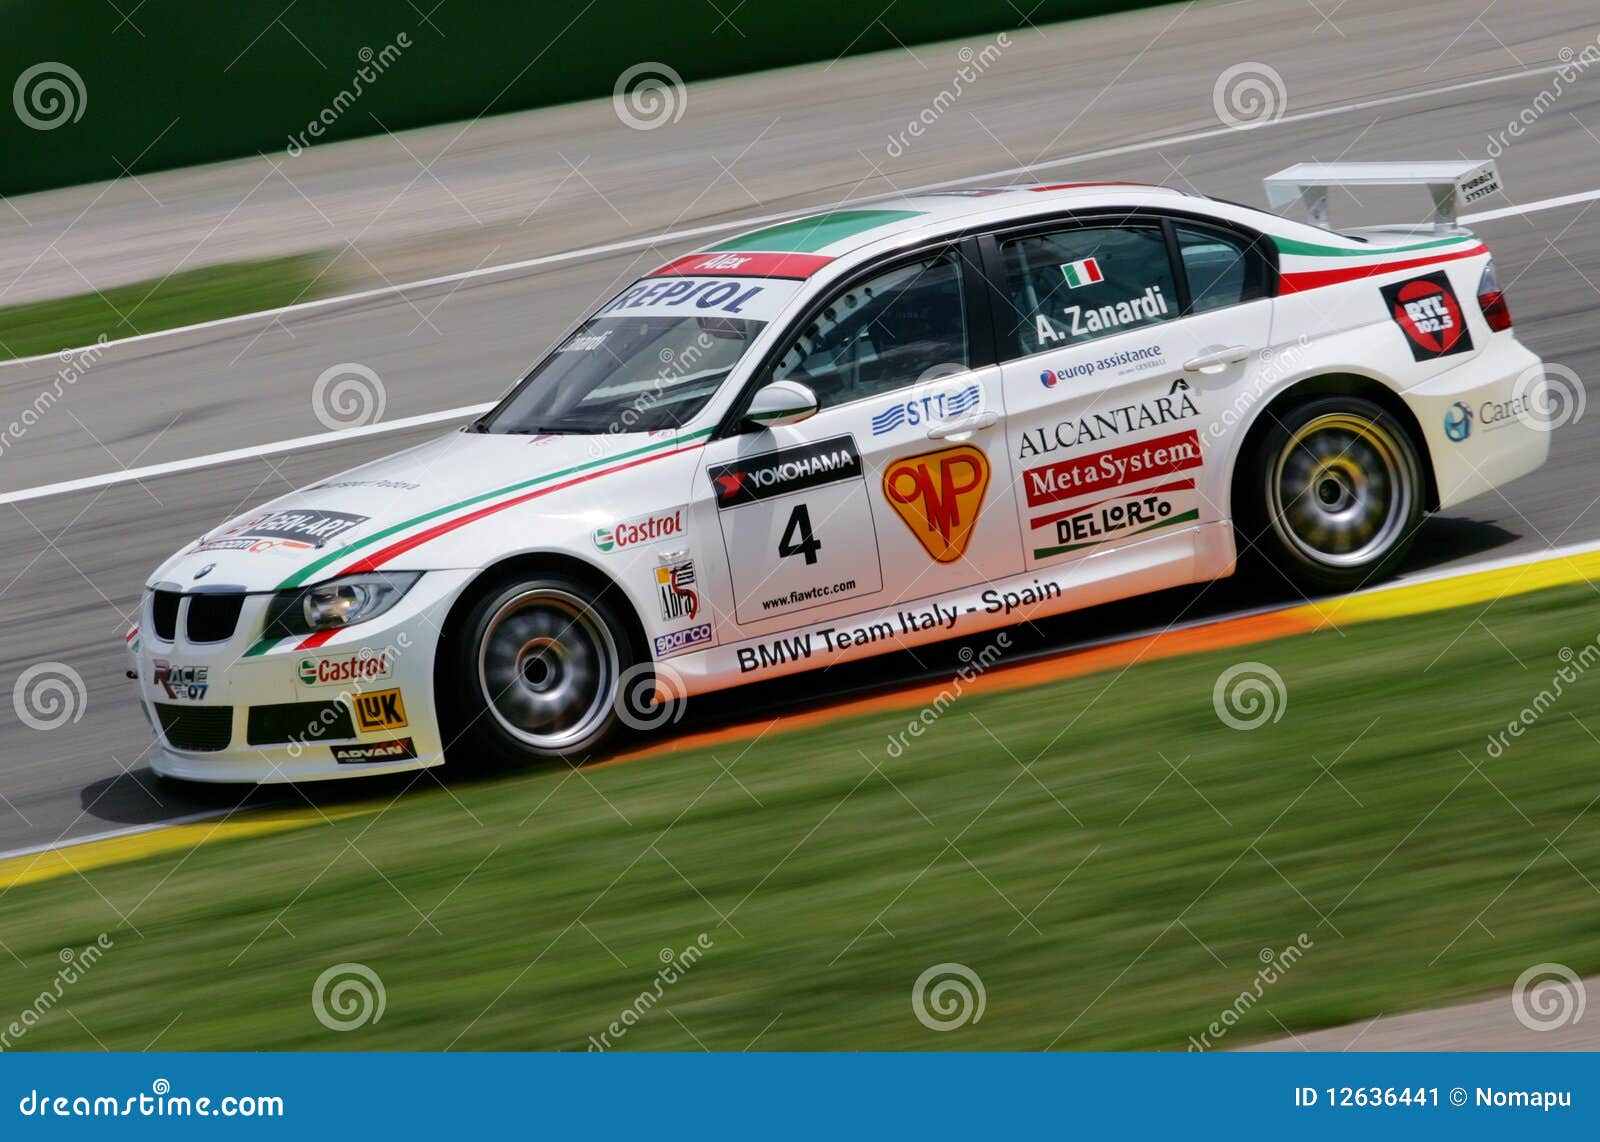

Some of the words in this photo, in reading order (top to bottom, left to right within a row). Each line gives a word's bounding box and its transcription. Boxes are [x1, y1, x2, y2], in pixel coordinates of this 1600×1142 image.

[1465, 182, 1499, 202] SYSTEM
[603, 279, 766, 314] REPSOL
[1404, 295, 1448, 322] RTL
[1036, 313, 1066, 345] A.
[1064, 285, 1169, 337] Zanardi
[1415, 315, 1454, 334] 102.5
[1057, 359, 1096, 381] europ
[1096, 345, 1163, 371] assistance
[907, 392, 947, 427] STT
[747, 449, 854, 488] YOKOHAMA
[615, 510, 683, 547] Castrol
[778, 503, 822, 566] 4
[761, 578, 857, 611] www.fiawtcc.com
[655, 624, 711, 651] sparco
[736, 633, 813, 673] BMW
[817, 621, 894, 653] Team
[897, 603, 958, 635] Italy
[980, 579, 1062, 615] Spain
[153, 659, 208, 699] RACE
[318, 651, 387, 684] Castrol
[187, 684, 208, 700] 07
[337, 745, 404, 759] ADVAN
